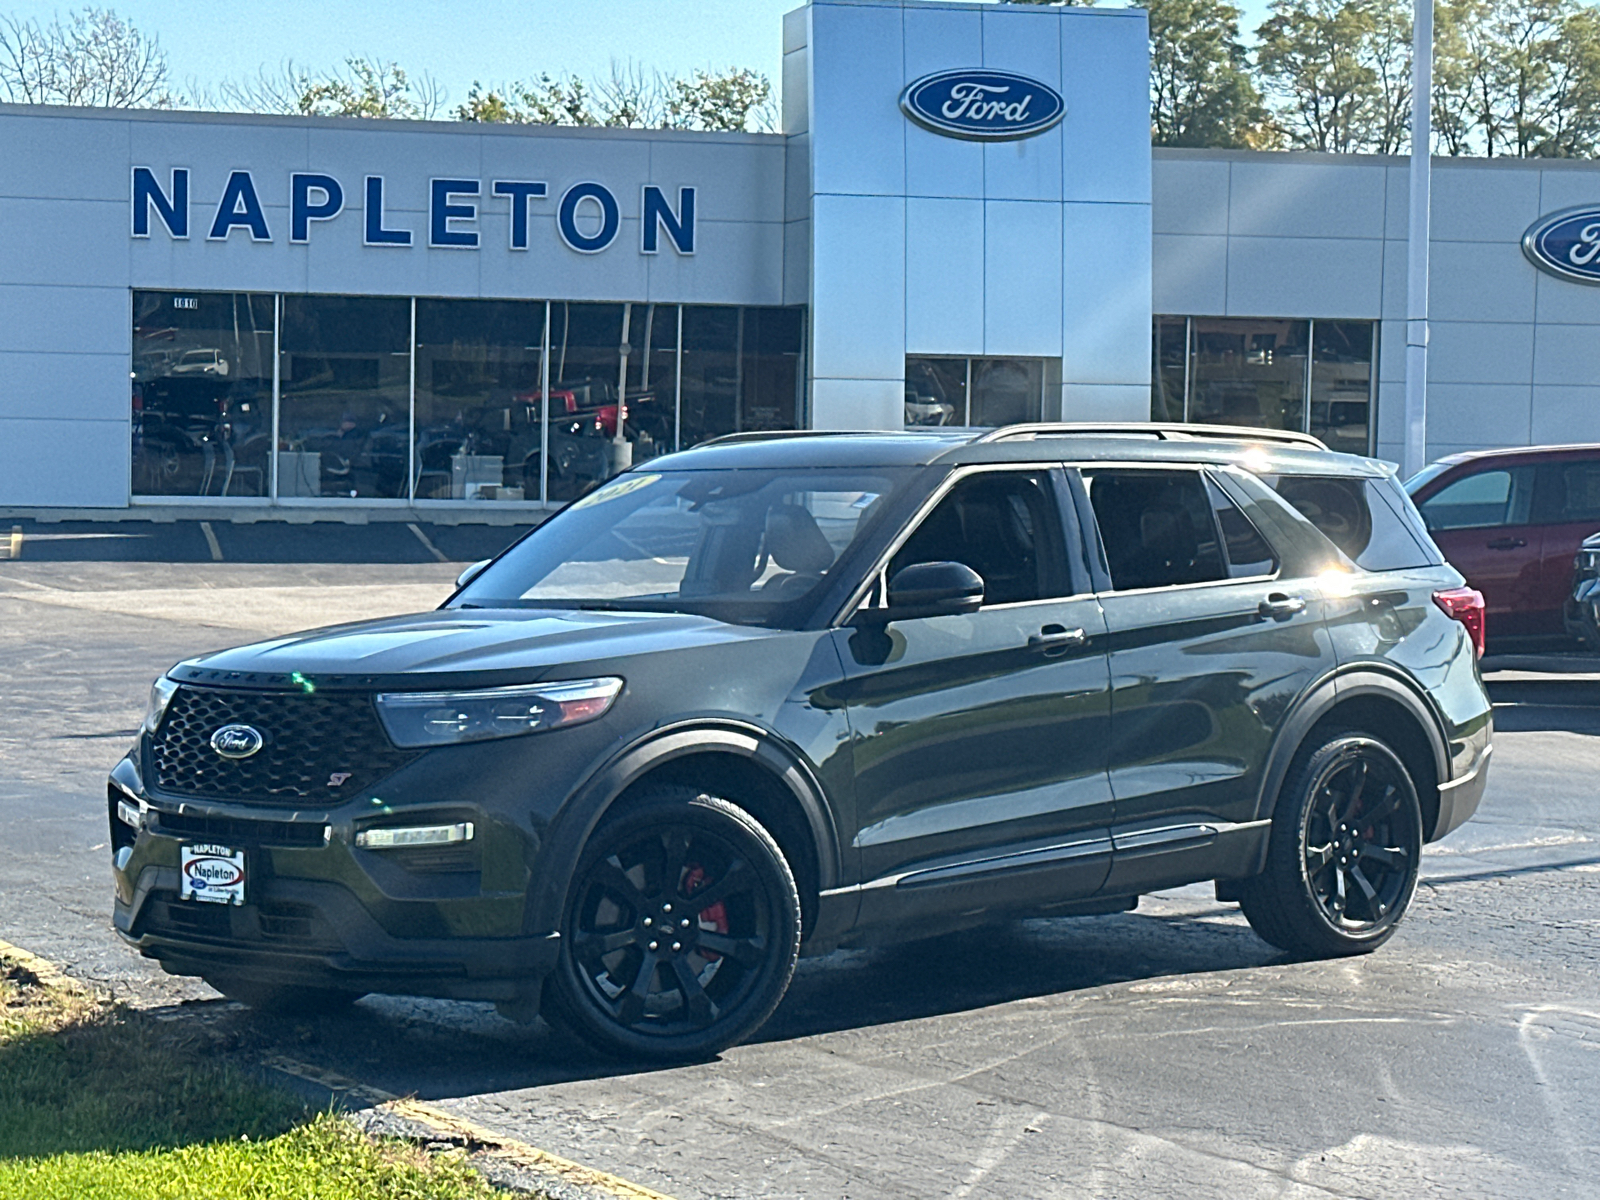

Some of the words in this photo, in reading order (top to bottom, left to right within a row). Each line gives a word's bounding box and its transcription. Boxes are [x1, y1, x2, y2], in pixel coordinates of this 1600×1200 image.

[941, 82, 1033, 122] Ford
[130, 166, 698, 256] NAPLETON
[1569, 223, 1600, 265] F
[220, 730, 249, 750] Ford
[326, 772, 353, 787] ST
[193, 844, 232, 857] NAPLETON
[194, 863, 234, 881] Napleton
